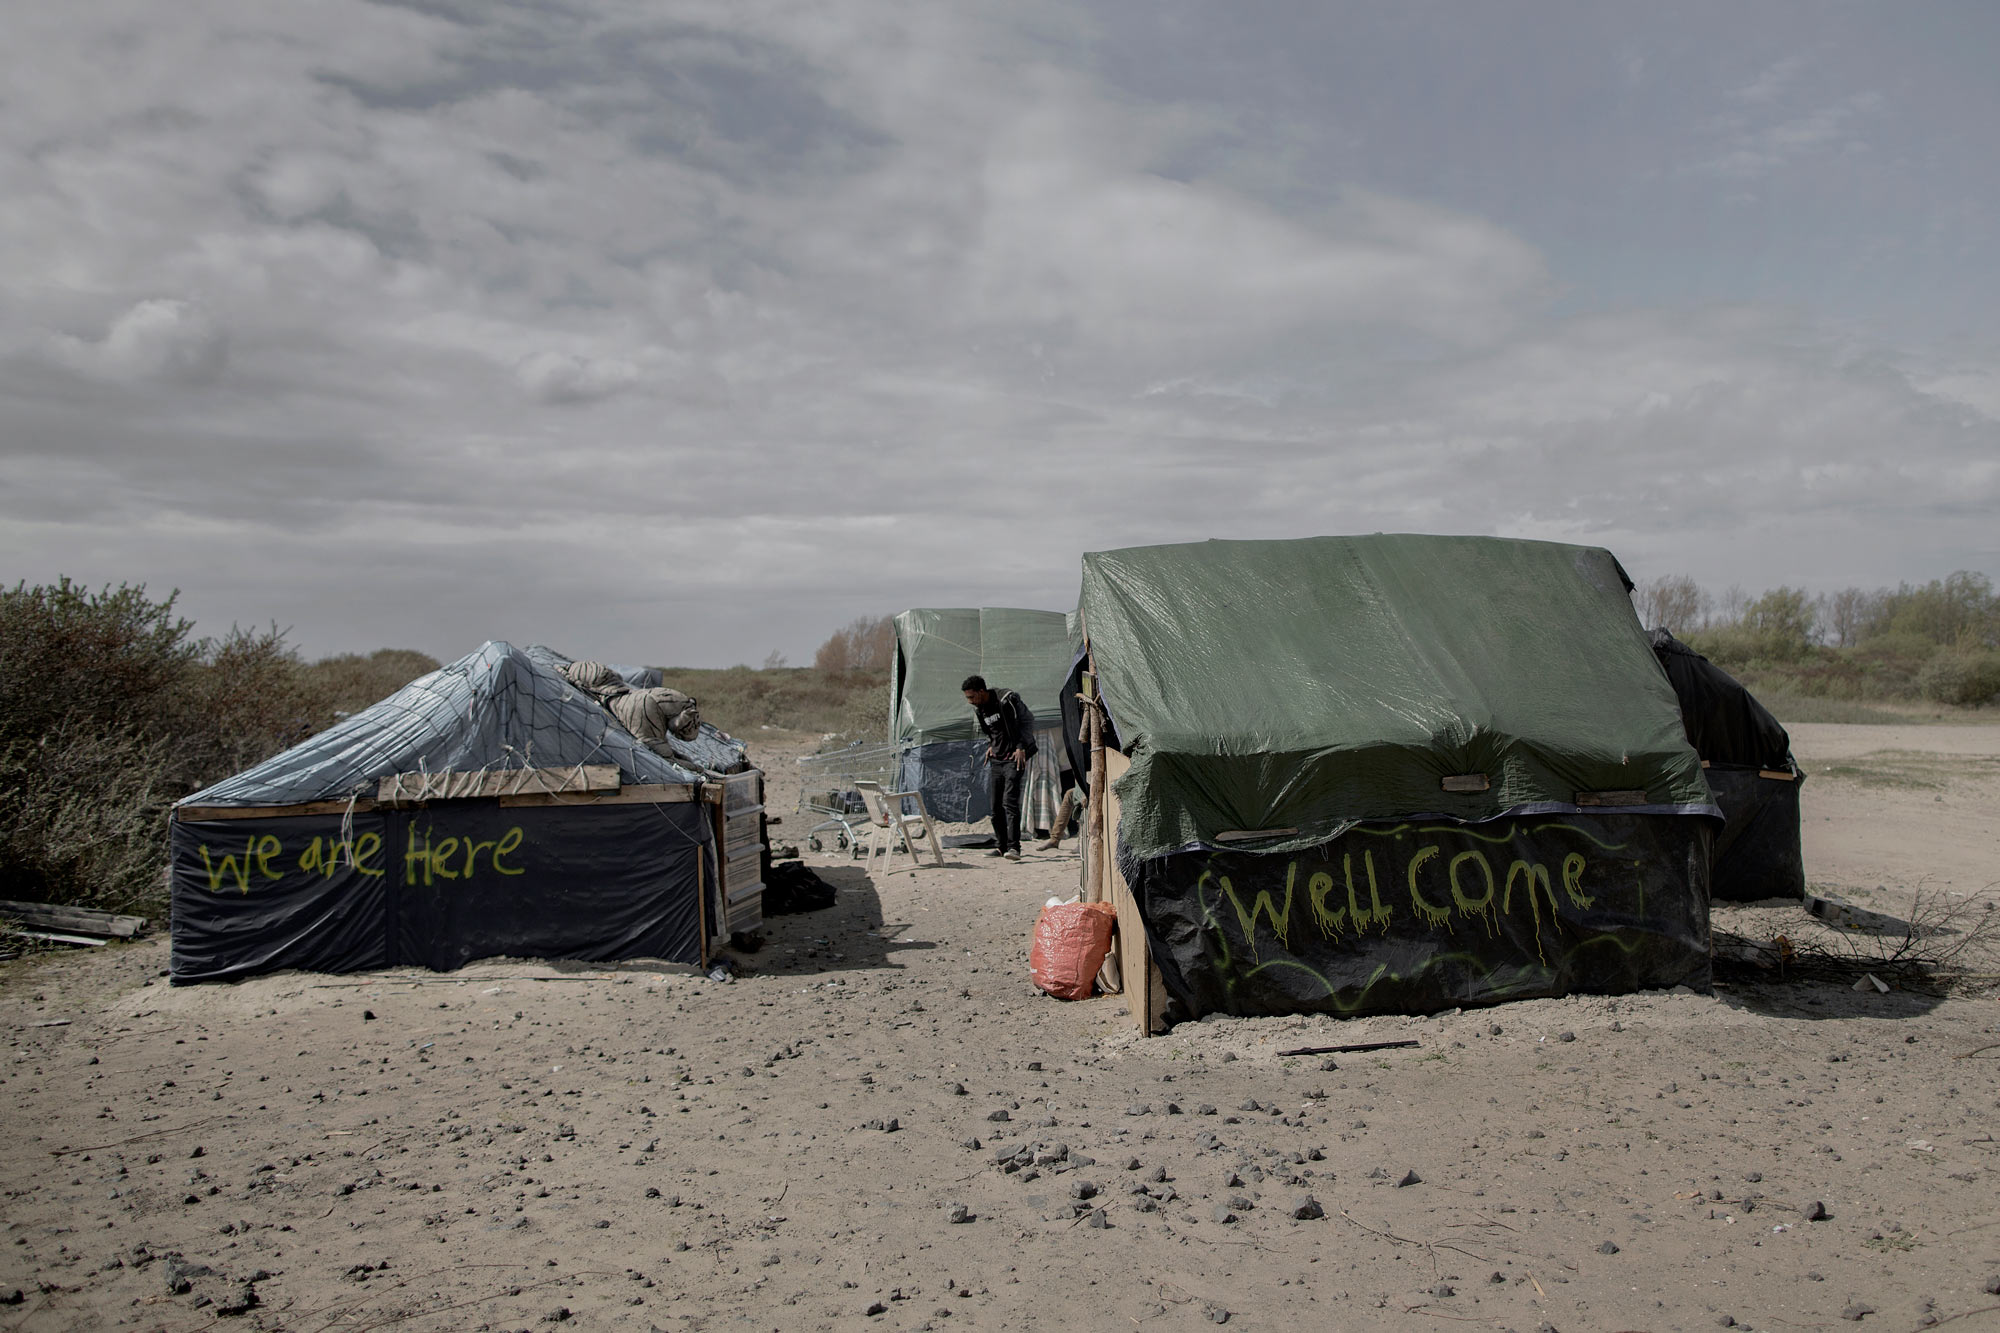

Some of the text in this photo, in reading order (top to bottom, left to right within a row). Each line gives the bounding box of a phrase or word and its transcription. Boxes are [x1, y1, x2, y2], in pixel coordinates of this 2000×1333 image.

[199, 820, 526, 893] We are Here
